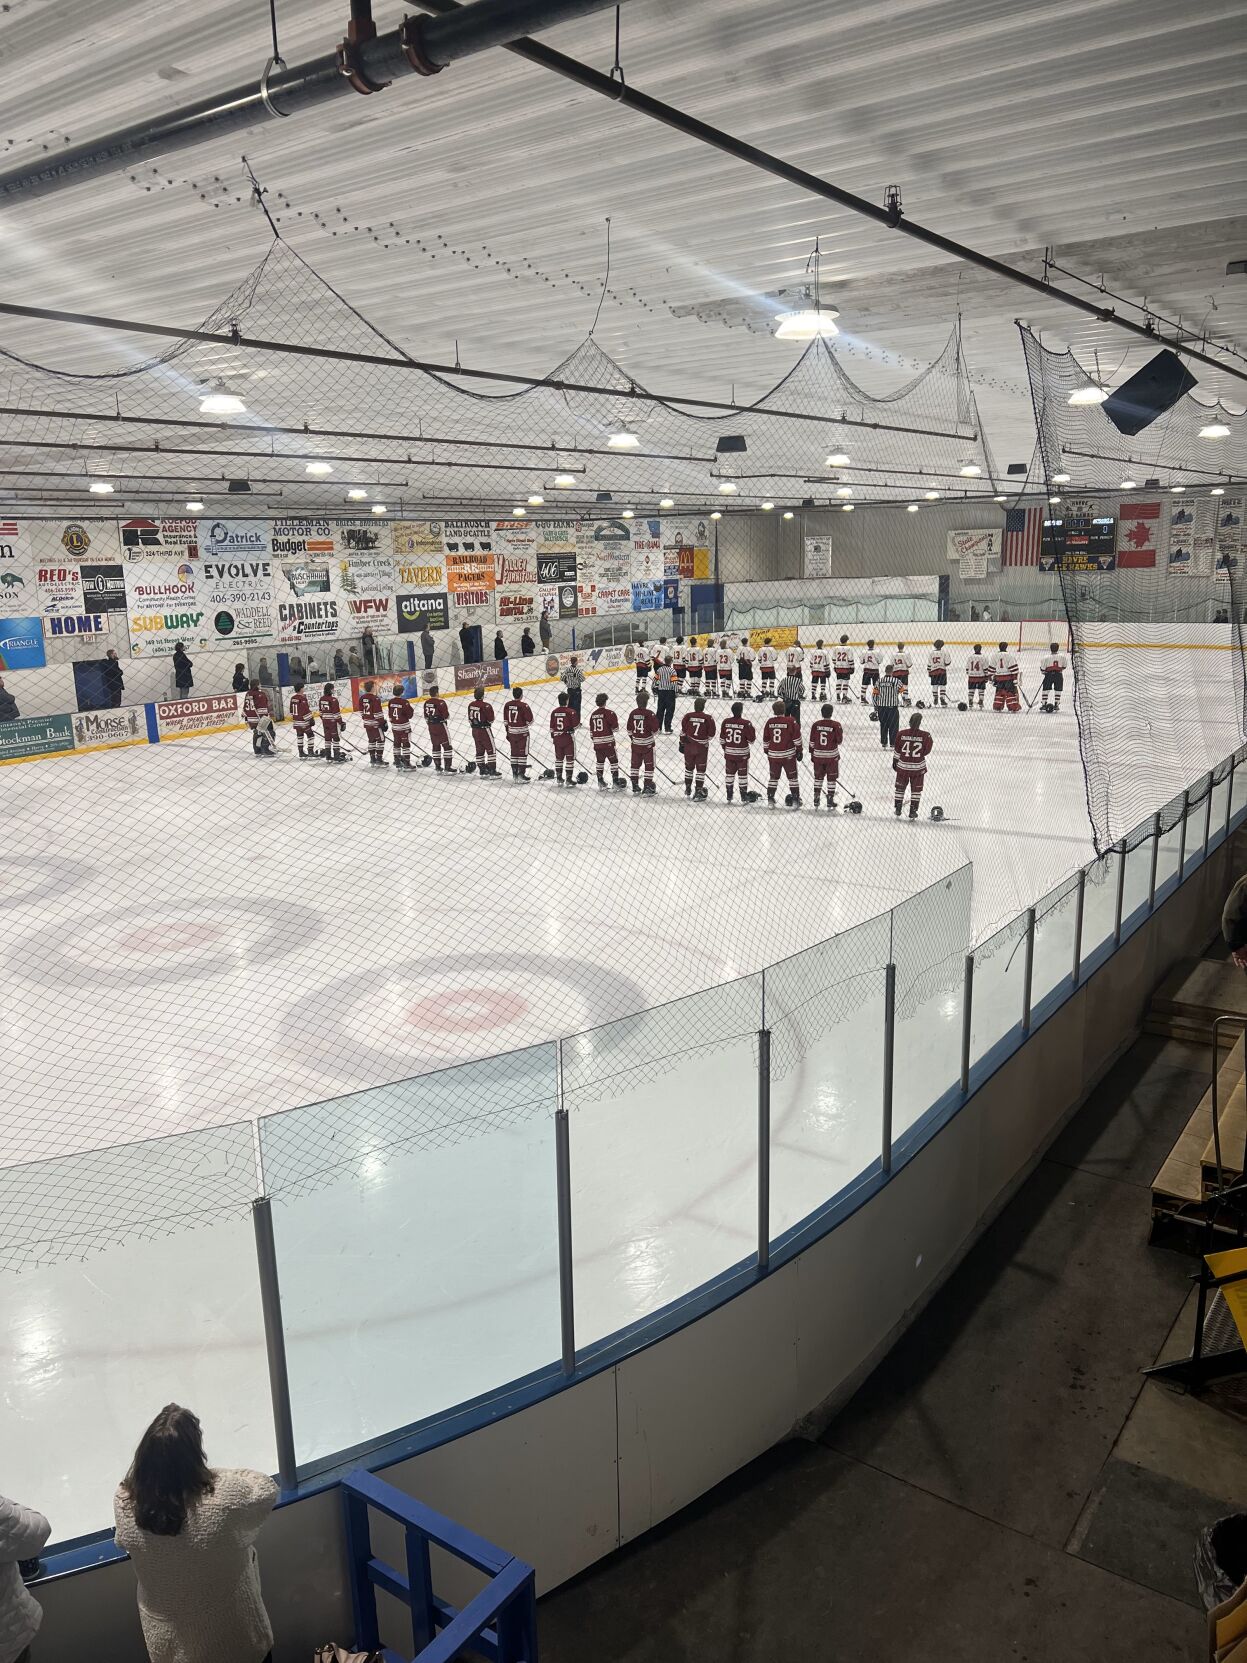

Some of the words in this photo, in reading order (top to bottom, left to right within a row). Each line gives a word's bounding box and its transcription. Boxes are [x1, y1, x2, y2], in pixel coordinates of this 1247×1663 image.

[162, 525, 198, 533] AGENCY
[273, 527, 312, 536] MOTOR
[317, 527, 333, 536] CO.
[445, 530, 463, 538] LAND
[272, 538, 307, 555] Budget
[38, 568, 79, 582] RED's
[204, 563, 271, 579] EVOLVE
[399, 566, 443, 584] TAVERN
[134, 582, 195, 595] BULLHOOK
[215, 580, 264, 589] ELECTRIC
[210, 592, 271, 604] 406-390-2143
[402, 598, 444, 611] altana
[456, 591, 488, 606] VISITORS
[234, 606, 271, 619] WADDELL
[279, 601, 337, 621] CABINETS
[352, 598, 389, 613] VFW
[50, 615, 103, 635] HOME
[131, 611, 204, 632] SUBWAY
[254, 618, 272, 629] REED
[297, 620, 338, 634] Countertops
[837, 652, 847, 661] 22
[457, 667, 483, 680] Shanty
[486, 666, 500, 675] Bar
[970, 661, 979, 671] 14
[160, 701, 207, 717] OXFORD
[212, 698, 235, 710] BAR
[292, 704, 298, 715] 11
[393, 708, 399, 720] 4
[508, 710, 518, 723] 17
[556, 717, 564, 730] 5
[593, 718, 604, 732] 19
[633, 720, 645, 733] 14
[692, 722, 701, 736] 7
[46, 726, 71, 739] Bank
[725, 729, 742, 744] 36
[773, 728, 781, 743] 8
[820, 731, 828, 746] 6
[901, 741, 923, 758] 42
